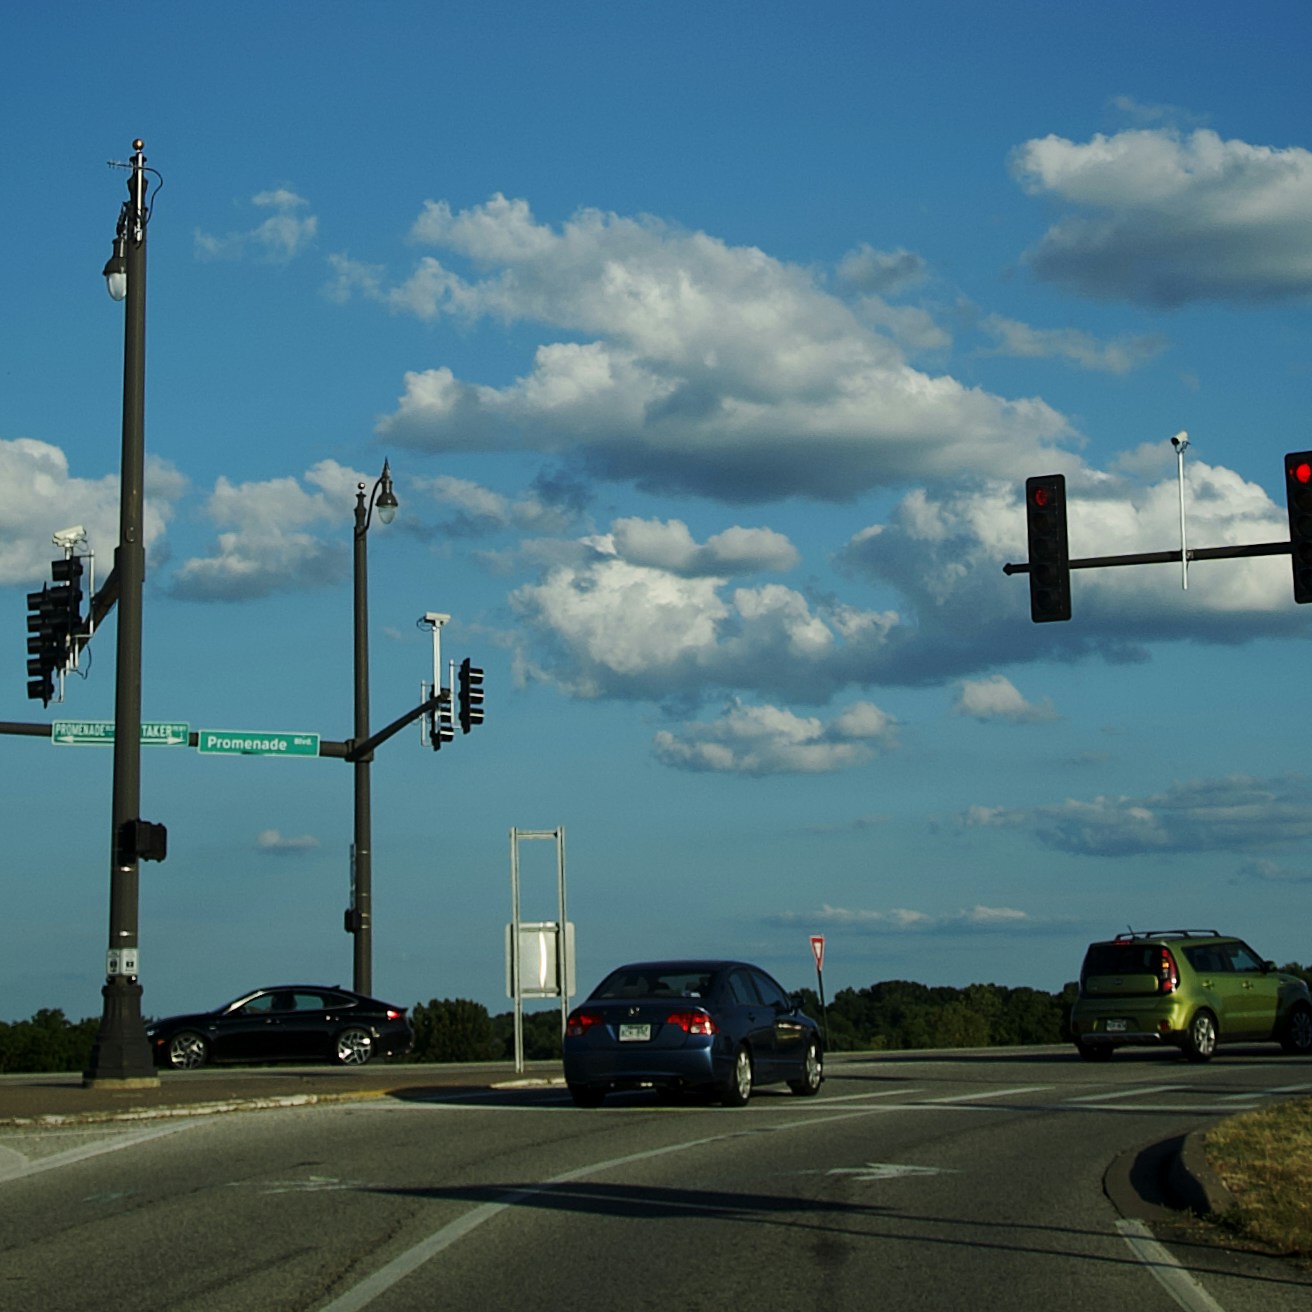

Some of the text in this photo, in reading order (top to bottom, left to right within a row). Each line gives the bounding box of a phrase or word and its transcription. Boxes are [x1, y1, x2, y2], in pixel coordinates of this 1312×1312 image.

[55, 723, 106, 737] PROMENADE
[141, 725, 172, 738] TAKER
[207, 736, 288, 751] Promenade
